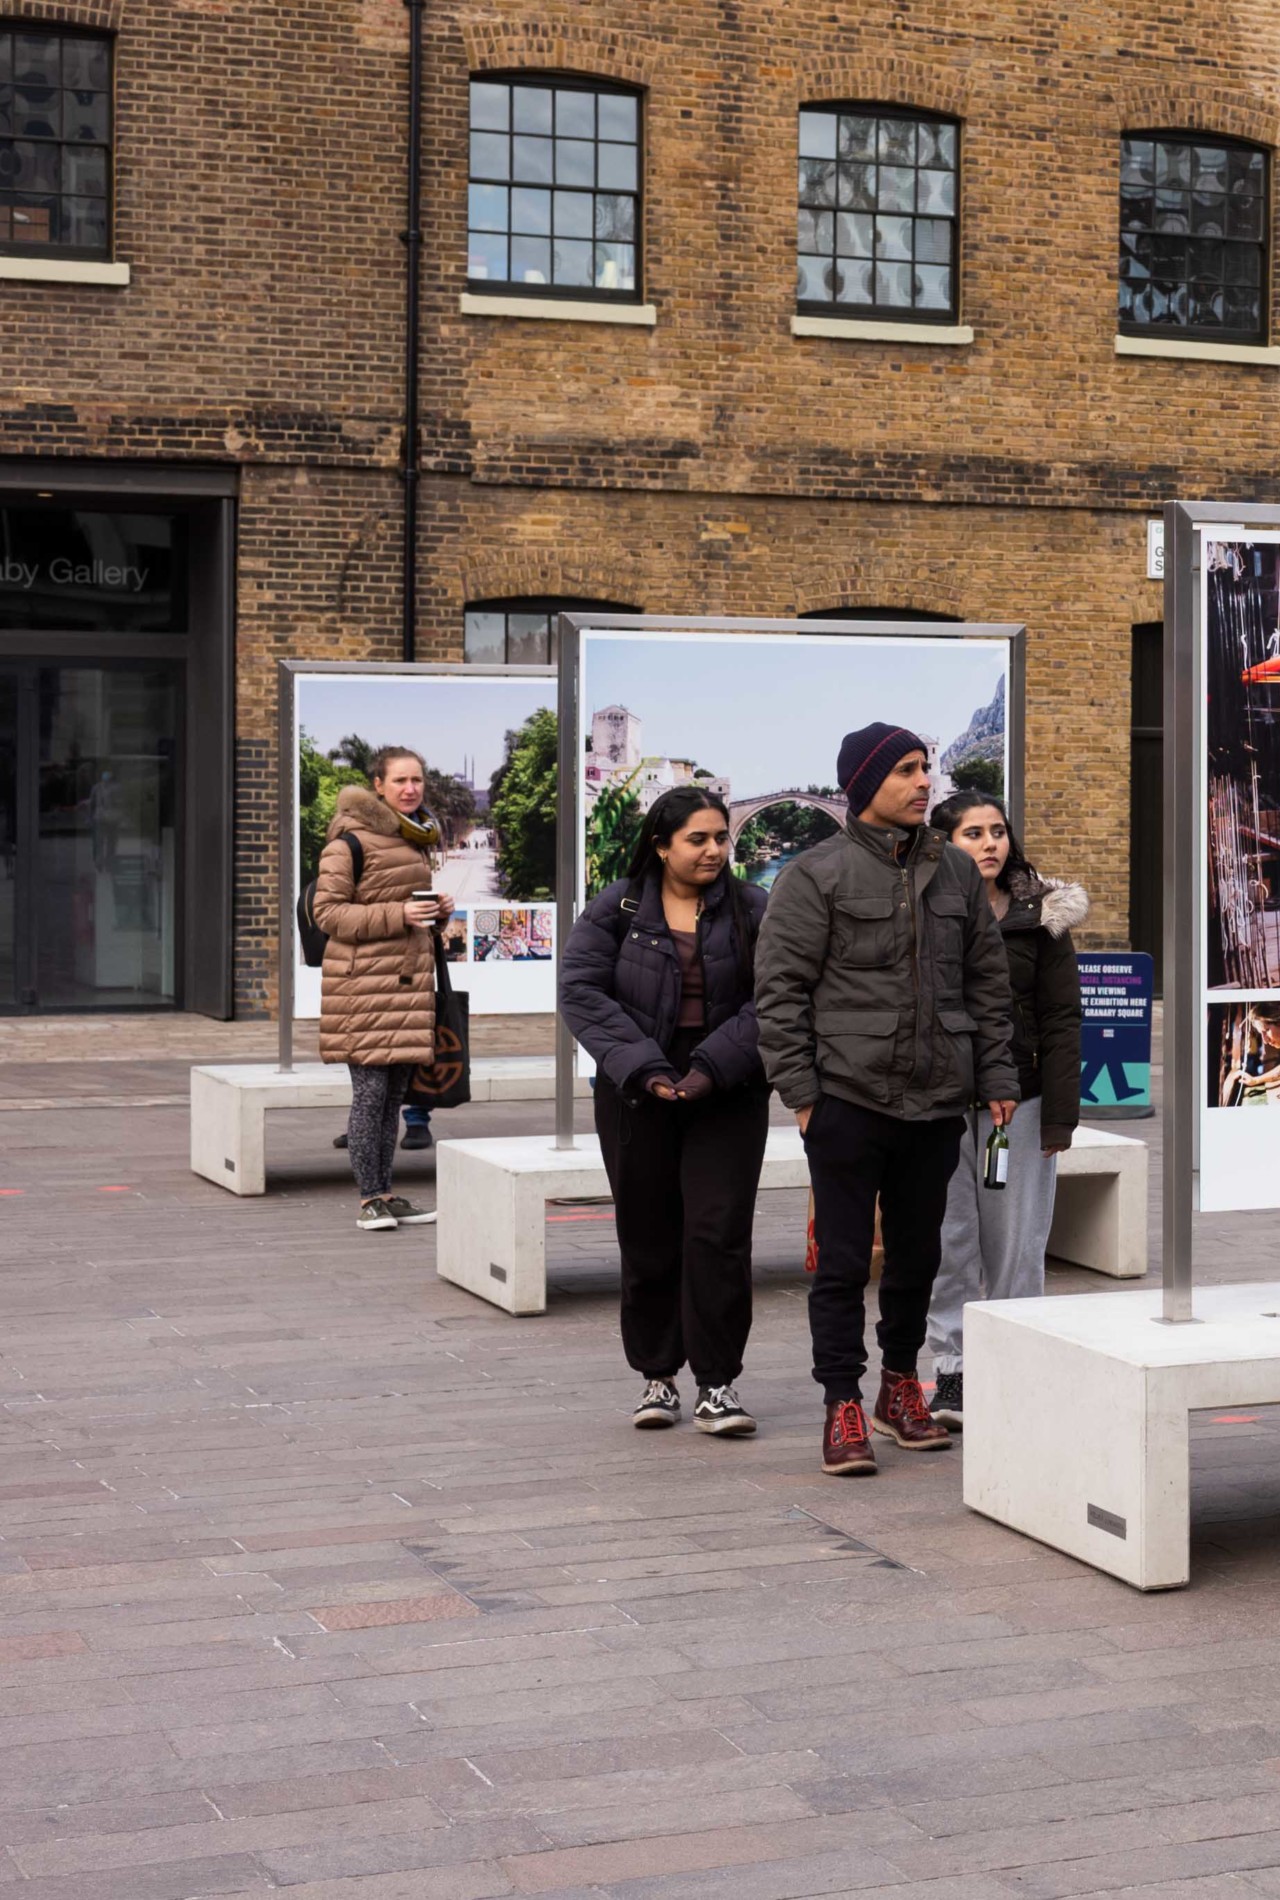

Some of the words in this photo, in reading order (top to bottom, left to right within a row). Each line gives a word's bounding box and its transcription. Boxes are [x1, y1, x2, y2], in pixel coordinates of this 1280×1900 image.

[49, 558, 149, 592] Gallery
[1078, 964, 1101, 974] PLEASE
[1102, 965, 1133, 974] OBSERVE
[1079, 976, 1100, 985] OCIAL
[1097, 986, 1127, 996] VIEWING
[1080, 997, 1089, 1006] HE
[1090, 997, 1129, 1007] EXHIBITION
[1130, 998, 1147, 1007] HERE
[1085, 1008, 1116, 1018] GRANARY
[1117, 1008, 1144, 1019] SQUARE
